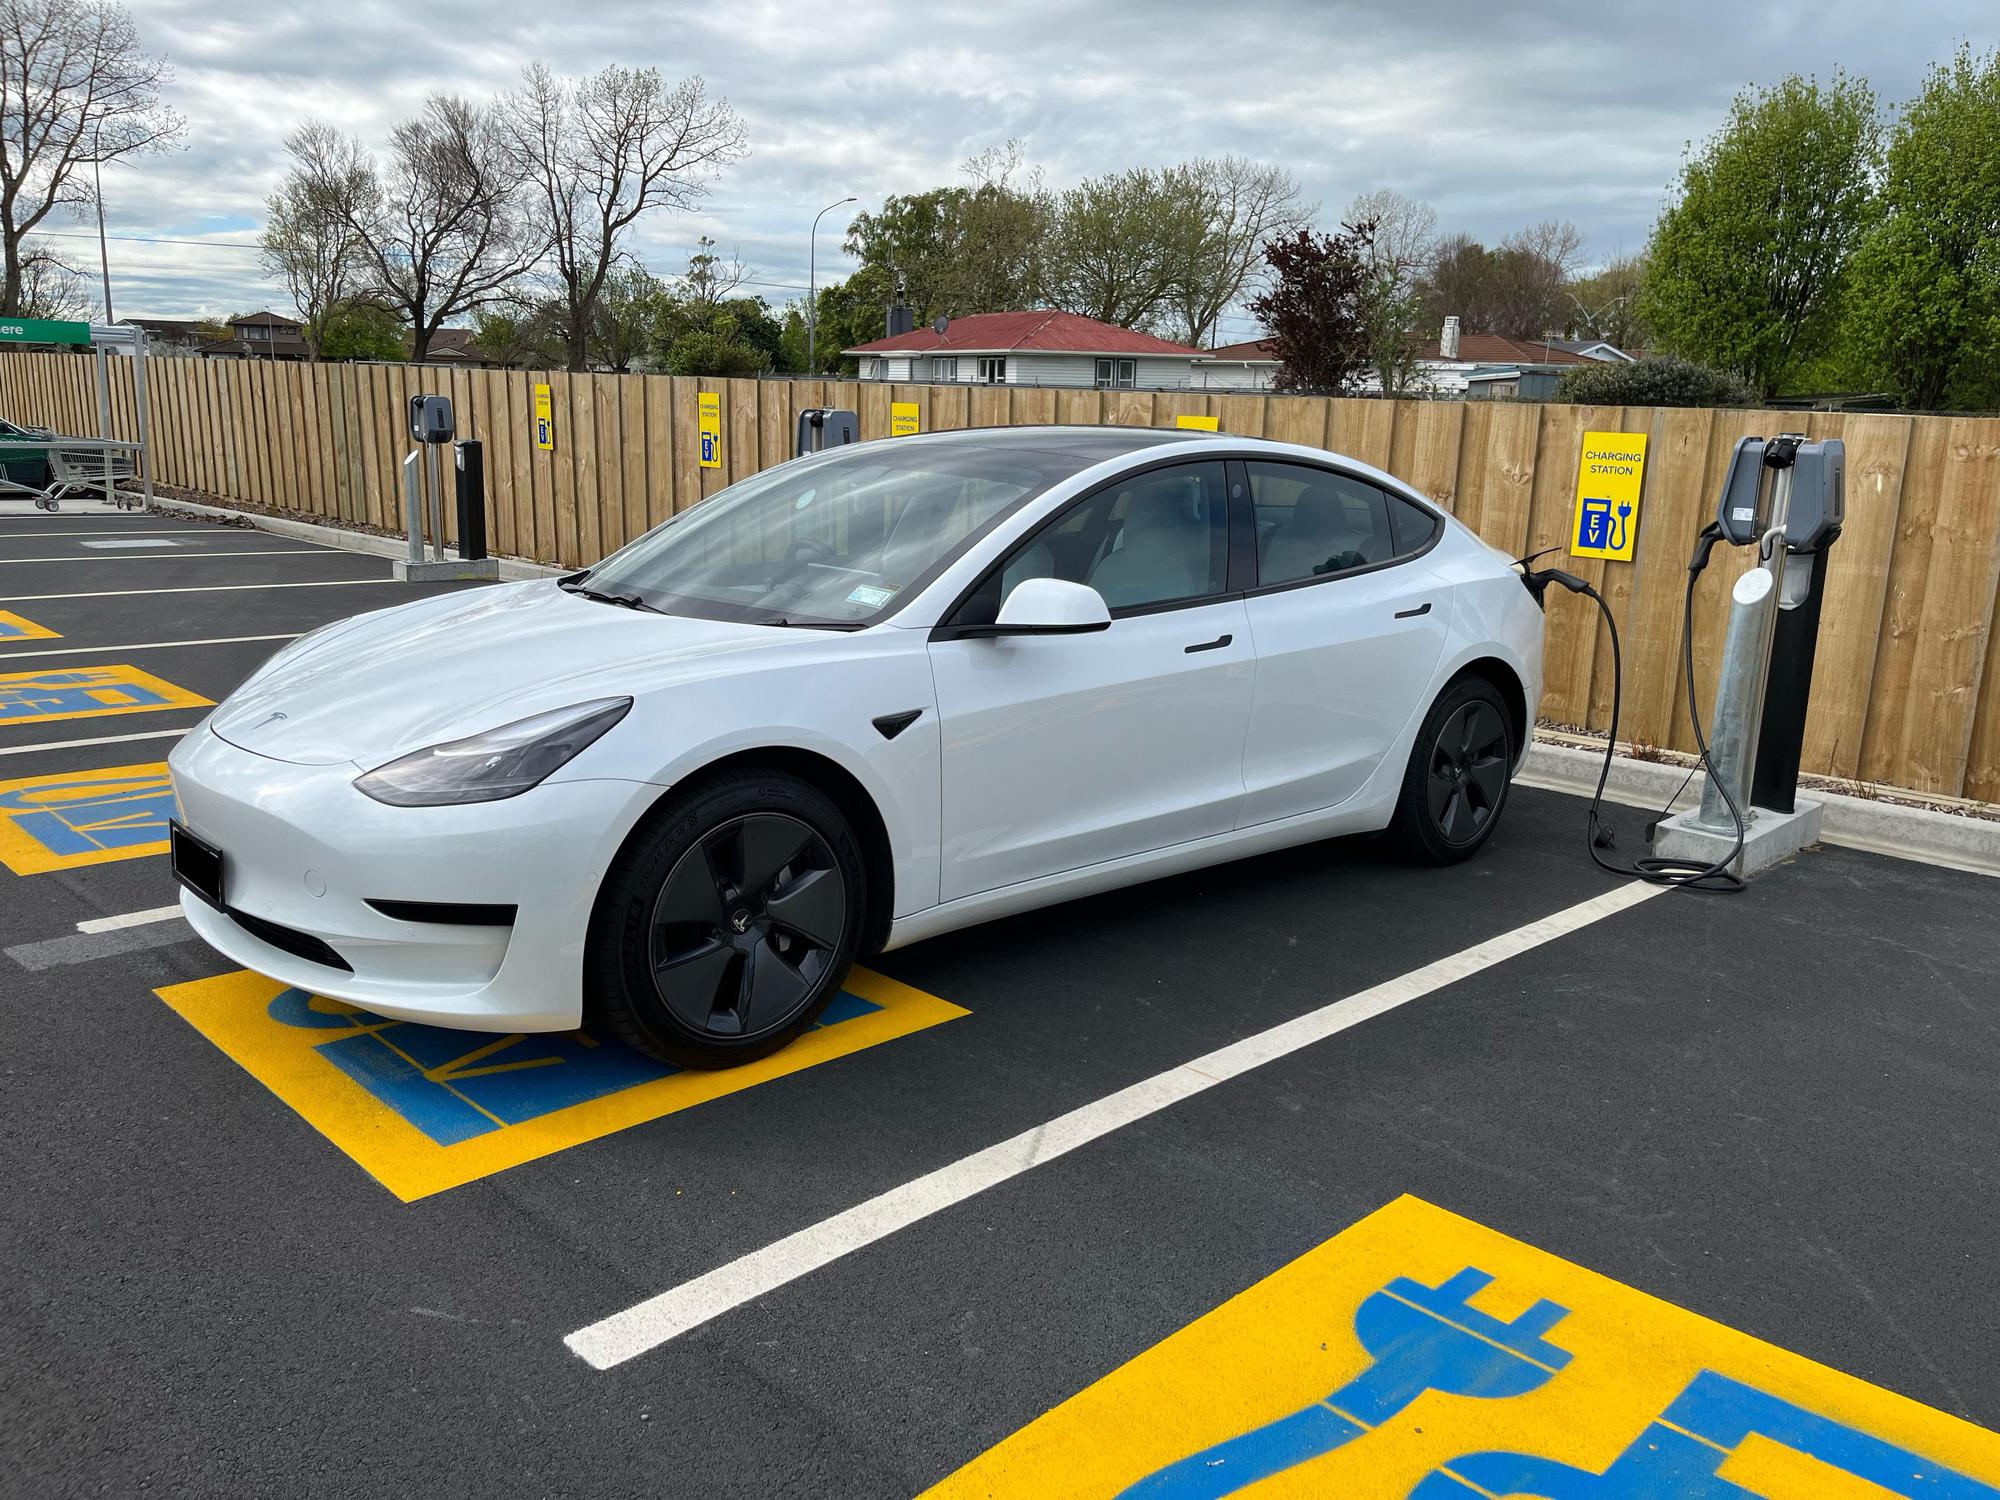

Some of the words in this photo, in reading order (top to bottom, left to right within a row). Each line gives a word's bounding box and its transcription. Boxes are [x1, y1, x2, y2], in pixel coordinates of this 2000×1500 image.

[0, 325, 24, 335] ere
[1585, 450, 1642, 462] CHARGING
[1590, 464, 1633, 475] STATION
